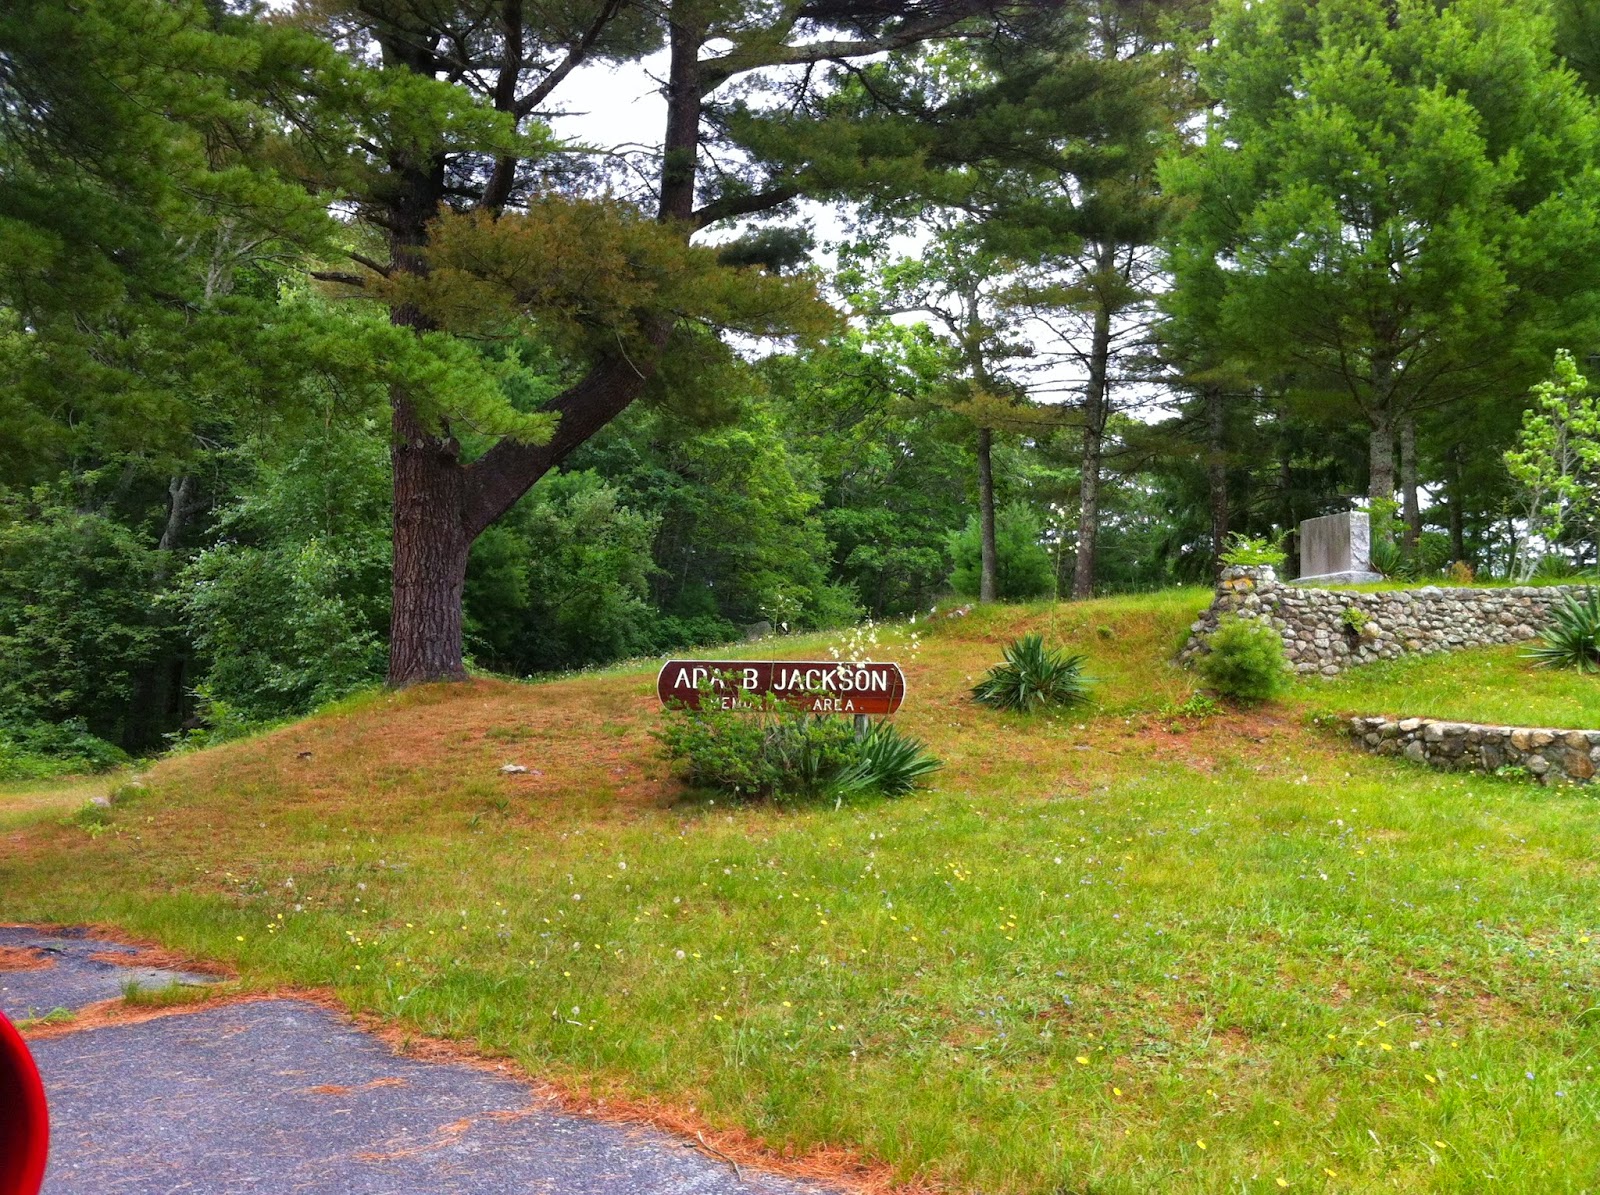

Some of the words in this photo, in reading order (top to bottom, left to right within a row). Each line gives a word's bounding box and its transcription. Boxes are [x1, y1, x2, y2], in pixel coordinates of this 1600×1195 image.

[743, 668, 759, 690] B
[774, 669, 887, 692] JACKSON
[813, 699, 855, 711] AREA
